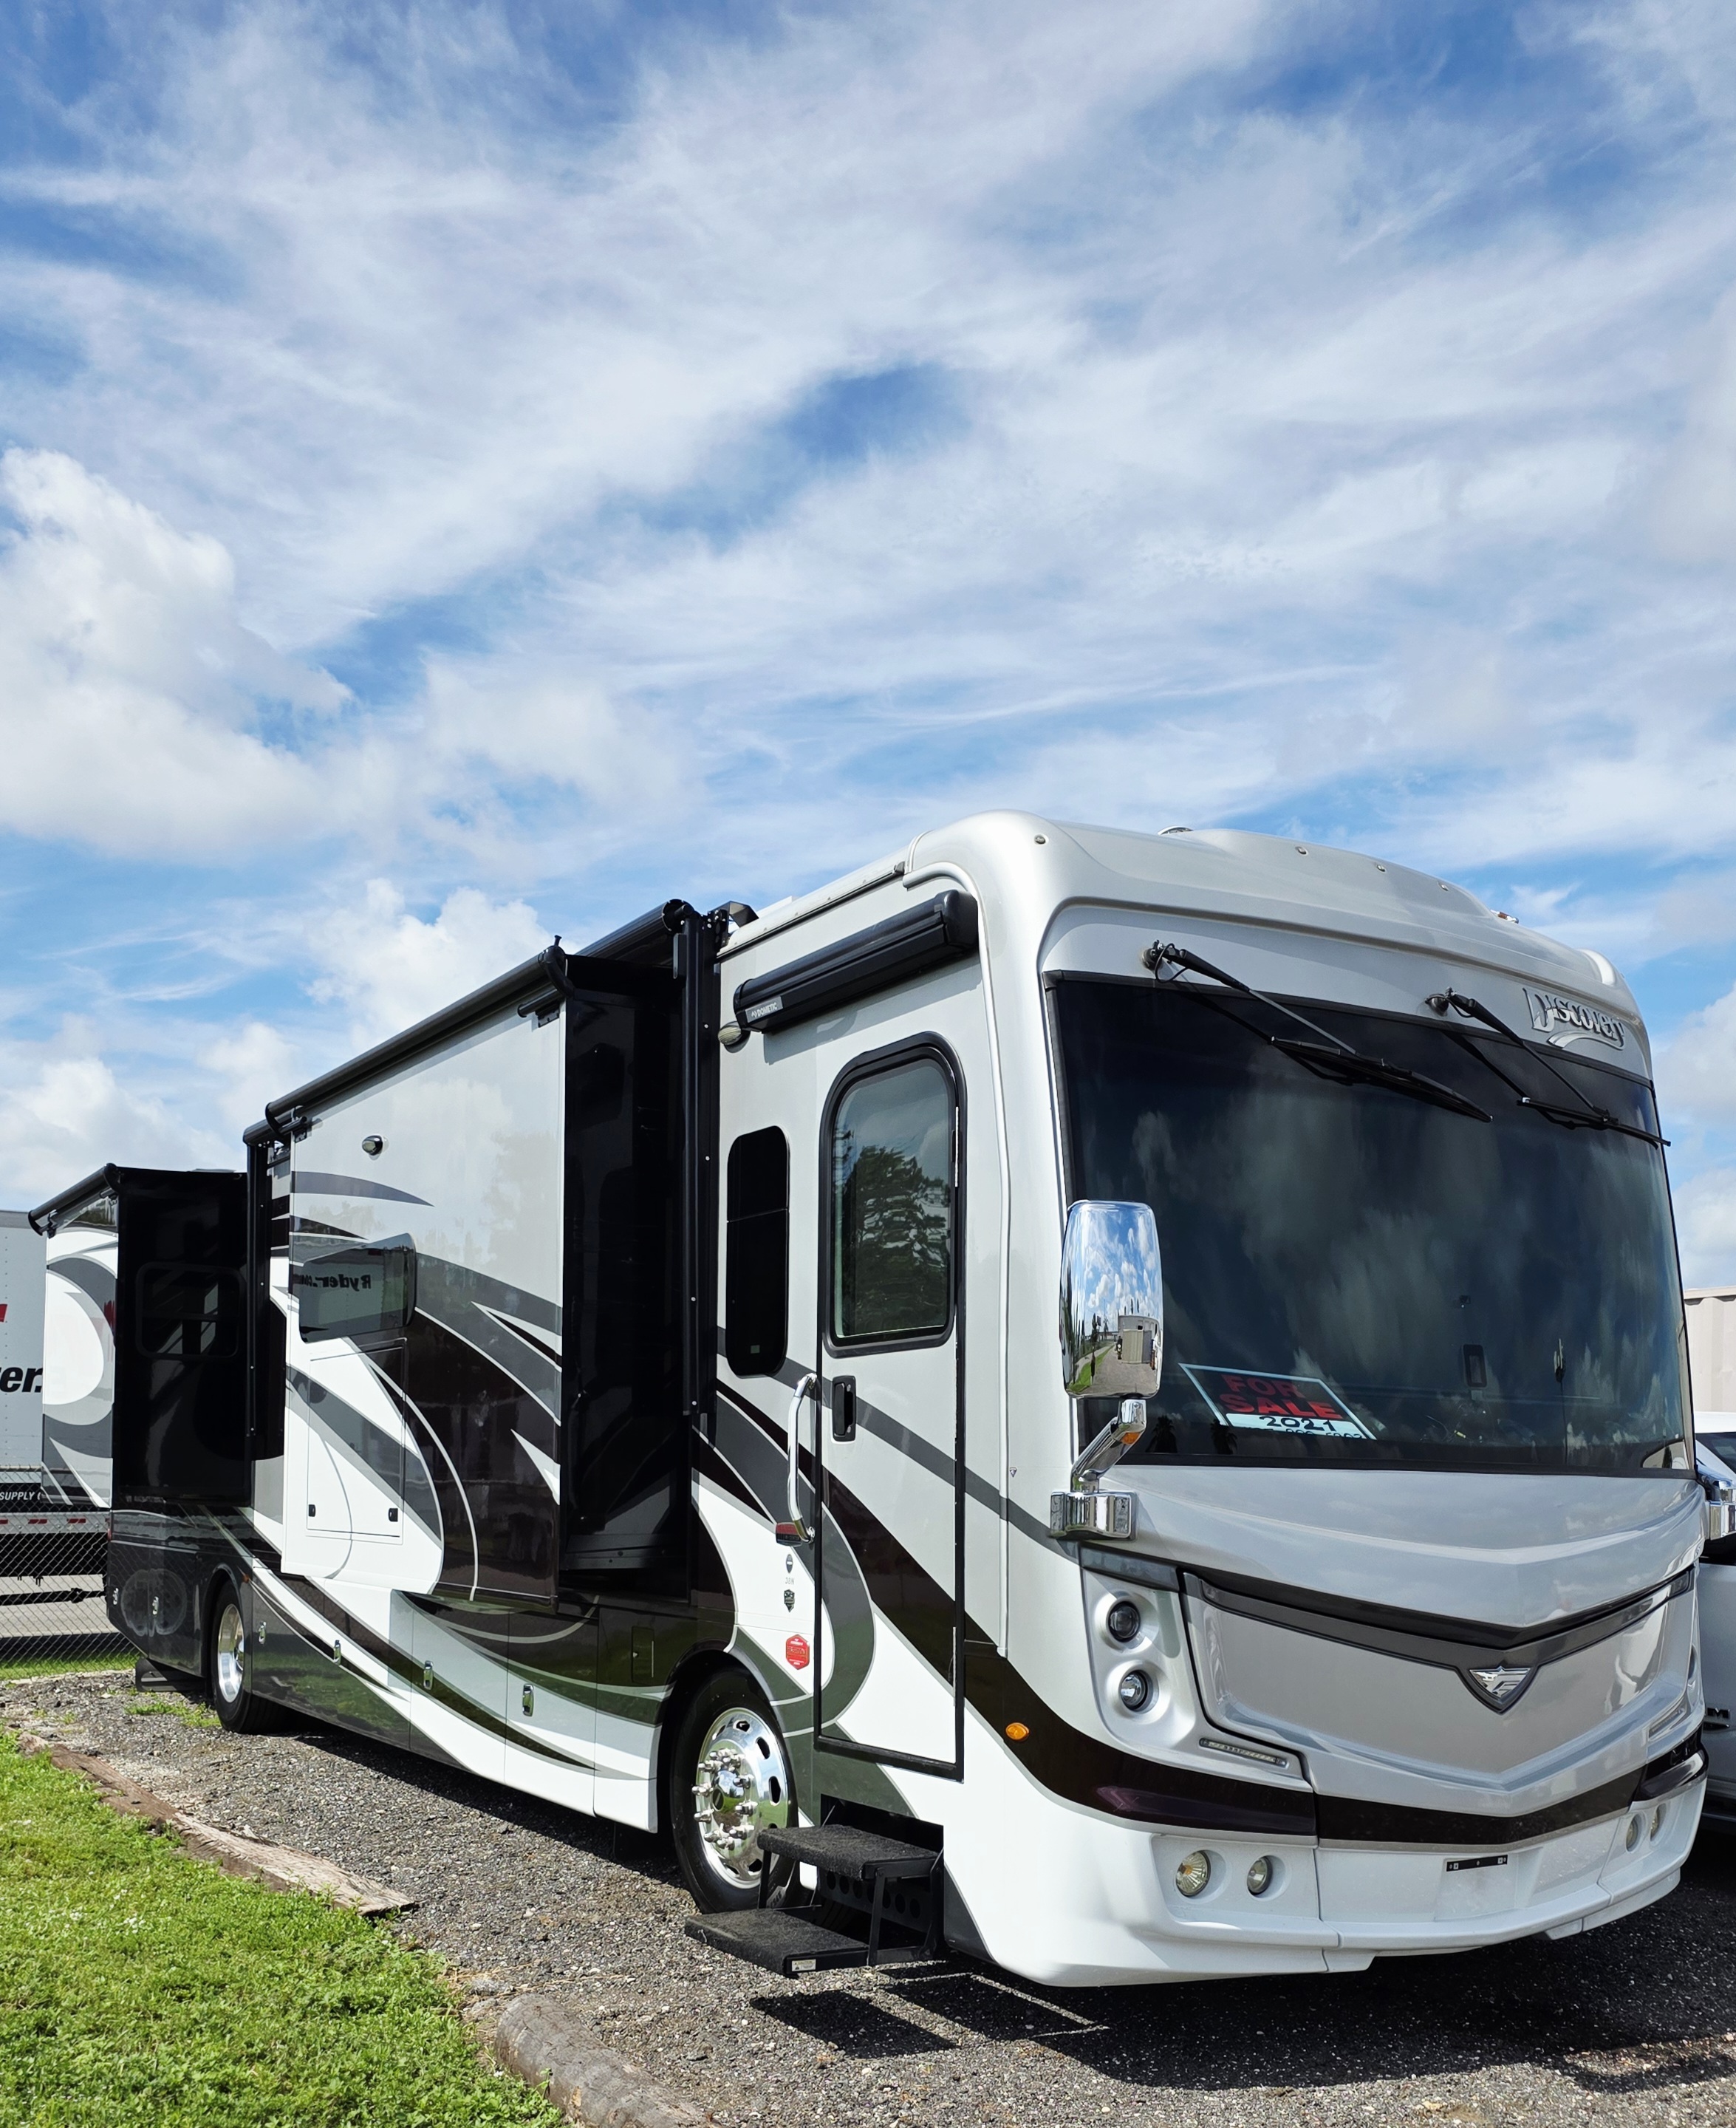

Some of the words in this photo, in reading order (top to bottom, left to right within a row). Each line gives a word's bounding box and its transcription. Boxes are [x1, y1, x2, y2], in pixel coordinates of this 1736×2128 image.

[756, 1002, 778, 1017] DOMETIC
[1523, 988, 1624, 1050] Discovery
[0, 1367, 43, 1393] er.
[1221, 1374, 1305, 1398] FOR
[1219, 1394, 1344, 1419] SALE
[1259, 1416, 1336, 1432] 2021
[0, 1491, 35, 1501] SUPPLY
